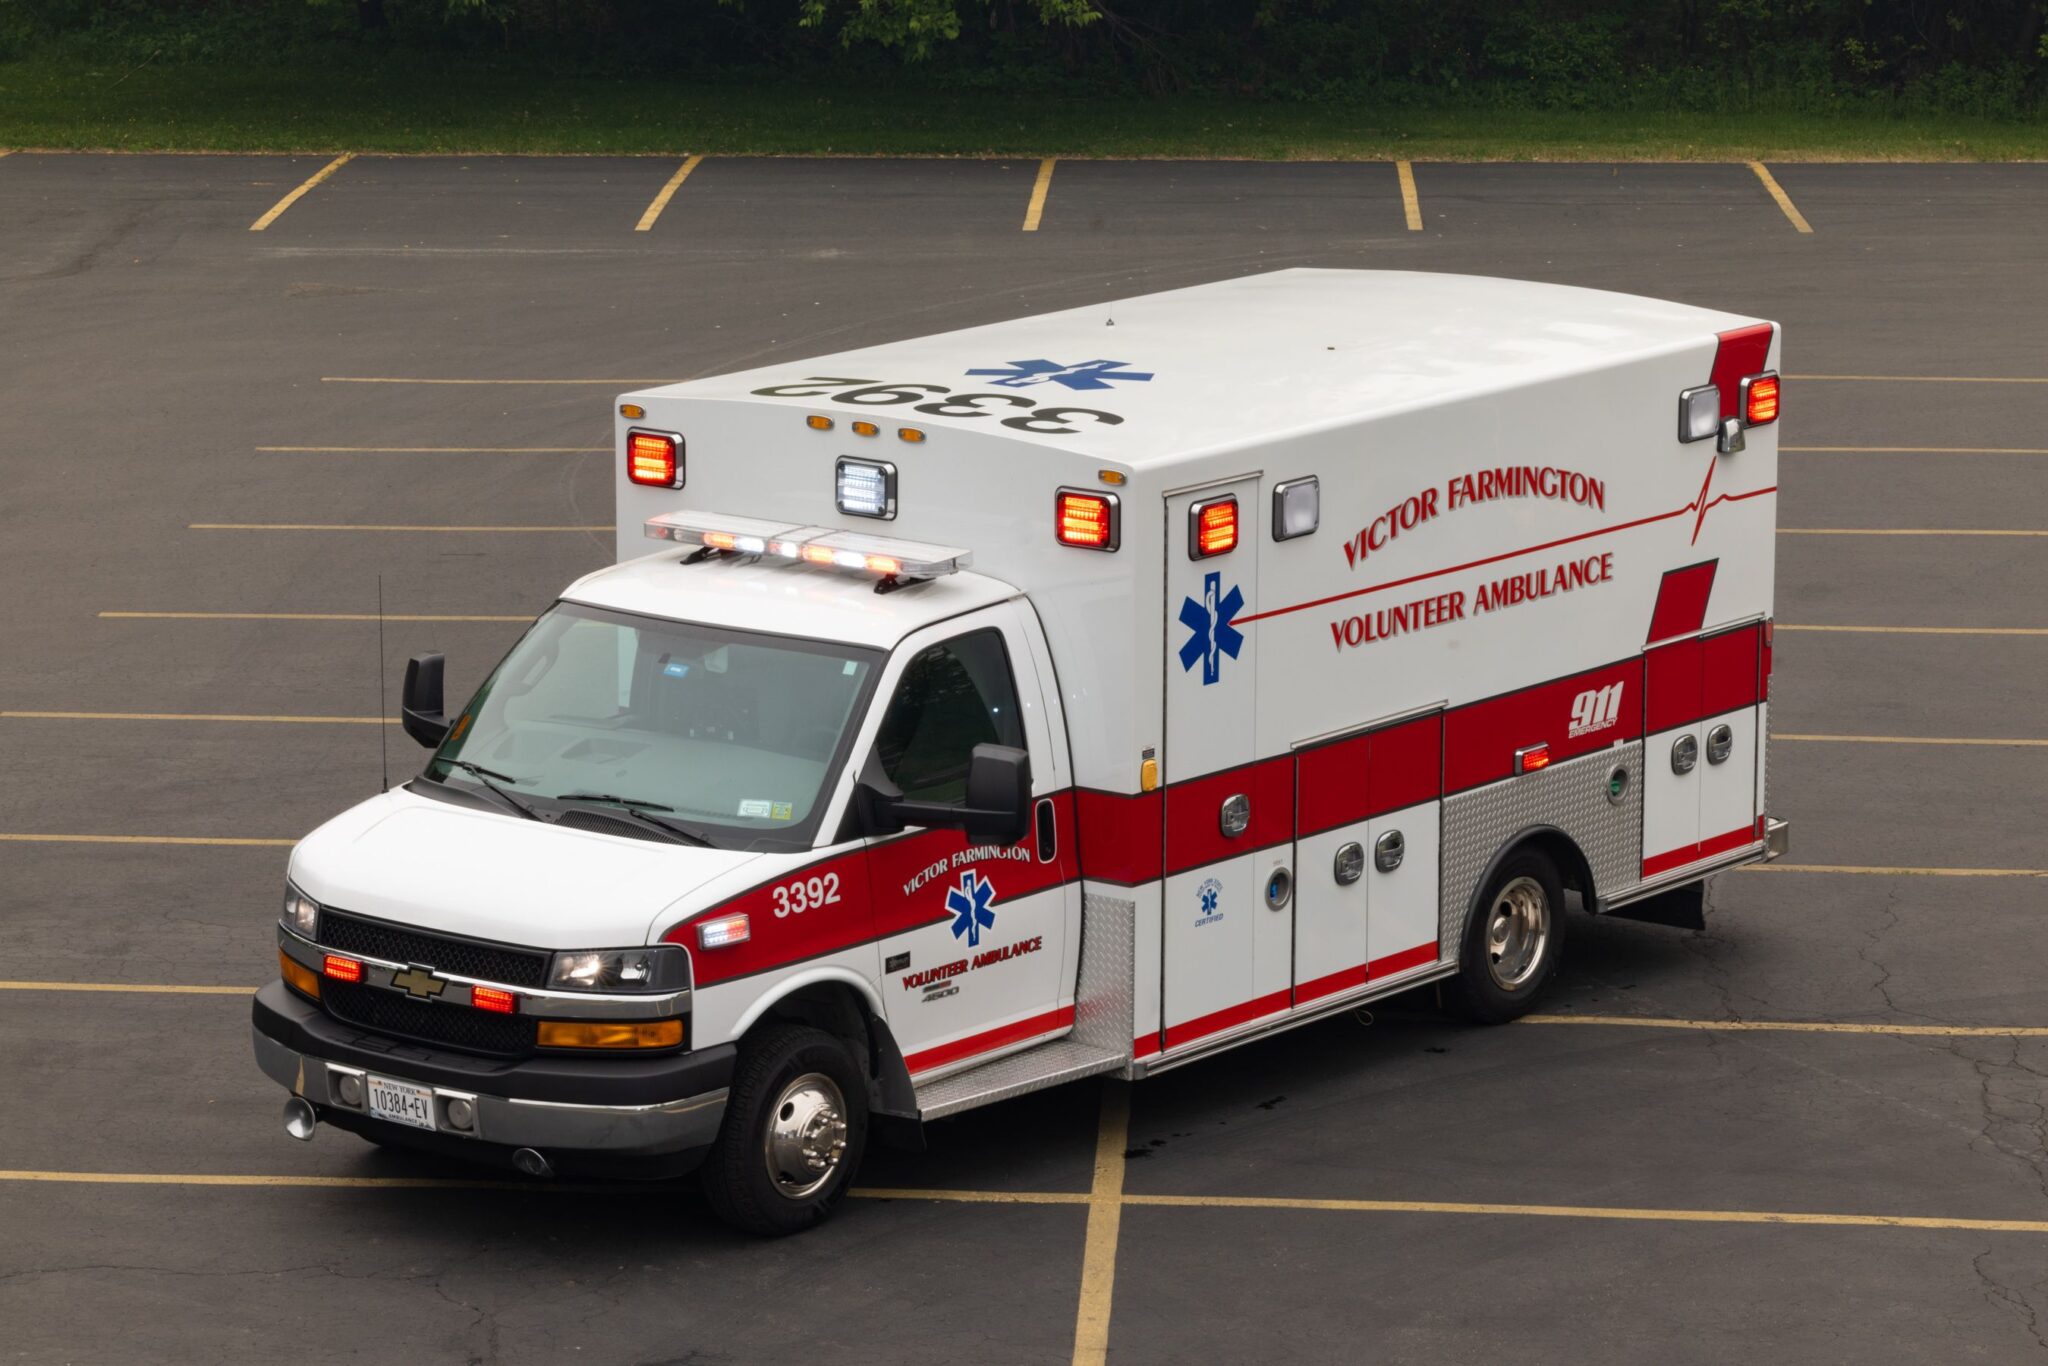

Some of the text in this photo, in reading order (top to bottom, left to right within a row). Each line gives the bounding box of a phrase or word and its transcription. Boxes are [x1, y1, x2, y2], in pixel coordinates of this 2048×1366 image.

[750, 376, 1125, 435] 3392
[1343, 466, 1605, 571] VICTOR FARMINGTON
[1330, 552, 1614, 654] VOLUNTEER AMBULANCE
[1568, 680, 1624, 731] 911
[1568, 717, 1618, 739] EMERGENCY
[772, 872, 841, 918] 3392
[903, 858, 948, 896] VICTOR
[1194, 913, 1224, 928] CERTIFIED
[902, 959, 969, 991] VOLUNTEER
[971, 936, 1042, 971] AMBULANCE
[383, 1082, 416, 1095] NEW YORK
